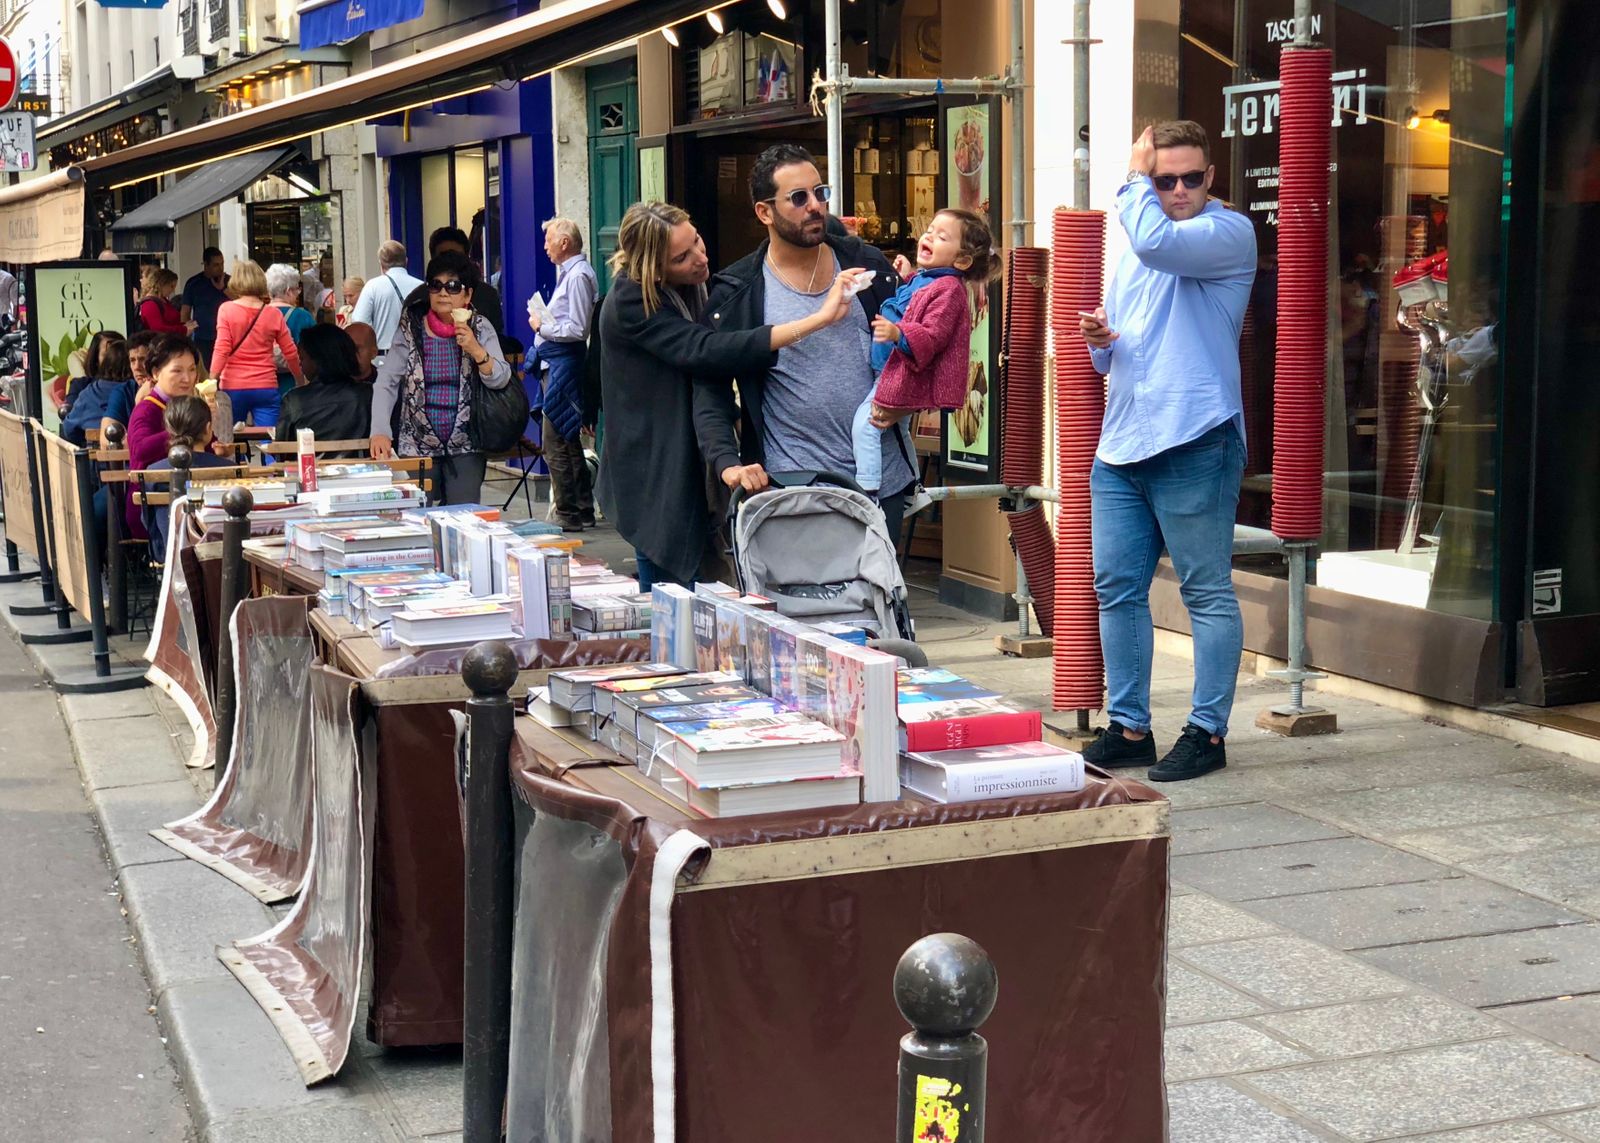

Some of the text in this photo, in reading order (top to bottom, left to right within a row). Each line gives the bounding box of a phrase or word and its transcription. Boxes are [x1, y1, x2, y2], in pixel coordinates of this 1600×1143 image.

[1266, 15, 1320, 42] TASCN
[13, 101, 48, 111] IRST
[1222, 69, 1367, 137] Ferri
[61, 283, 92, 300] GE
[61, 301, 90, 318] LA
[974, 775, 1058, 794] impressionniste
